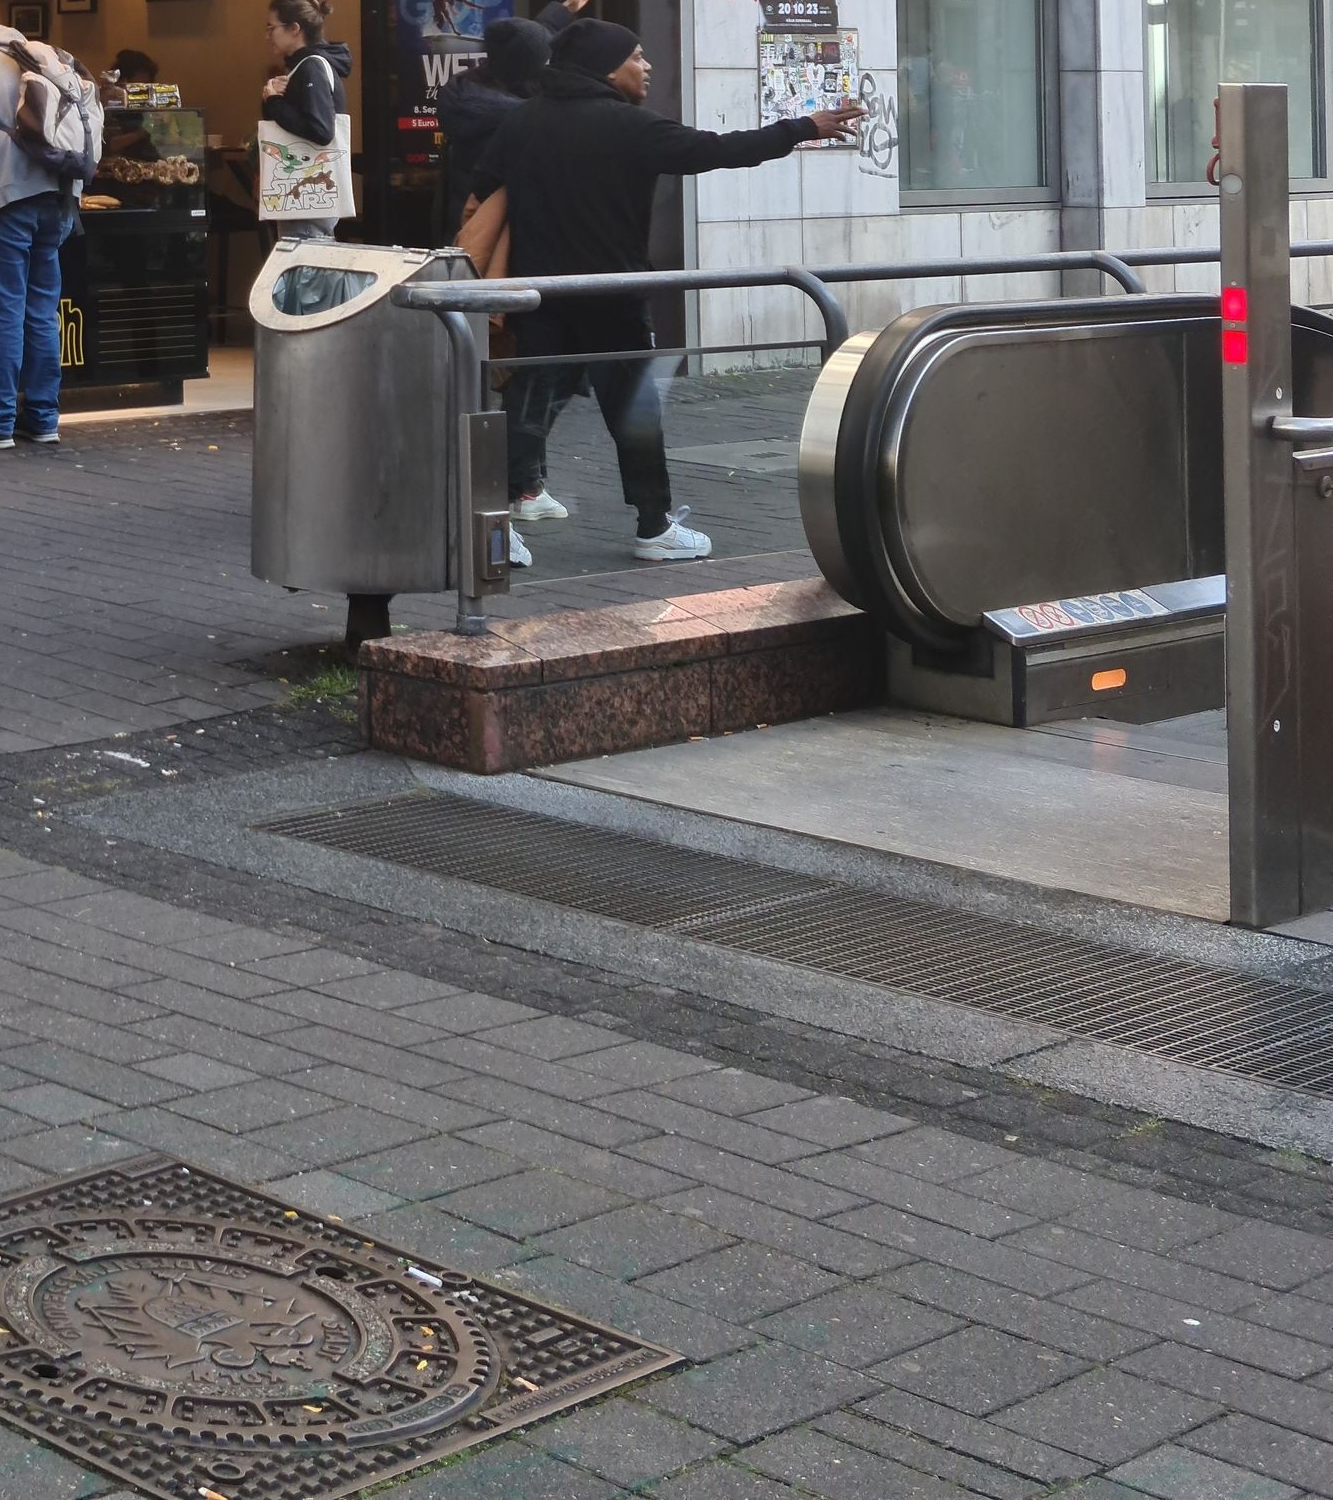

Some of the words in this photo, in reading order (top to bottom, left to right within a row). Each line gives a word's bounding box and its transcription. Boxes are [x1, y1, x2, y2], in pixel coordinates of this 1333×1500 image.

[778, 3, 792, 15] 20
[793, 2, 806, 15] 10
[807, 2, 820, 15] 23
[262, 178, 338, 197] STAR
[261, 192, 339, 213] WARS
